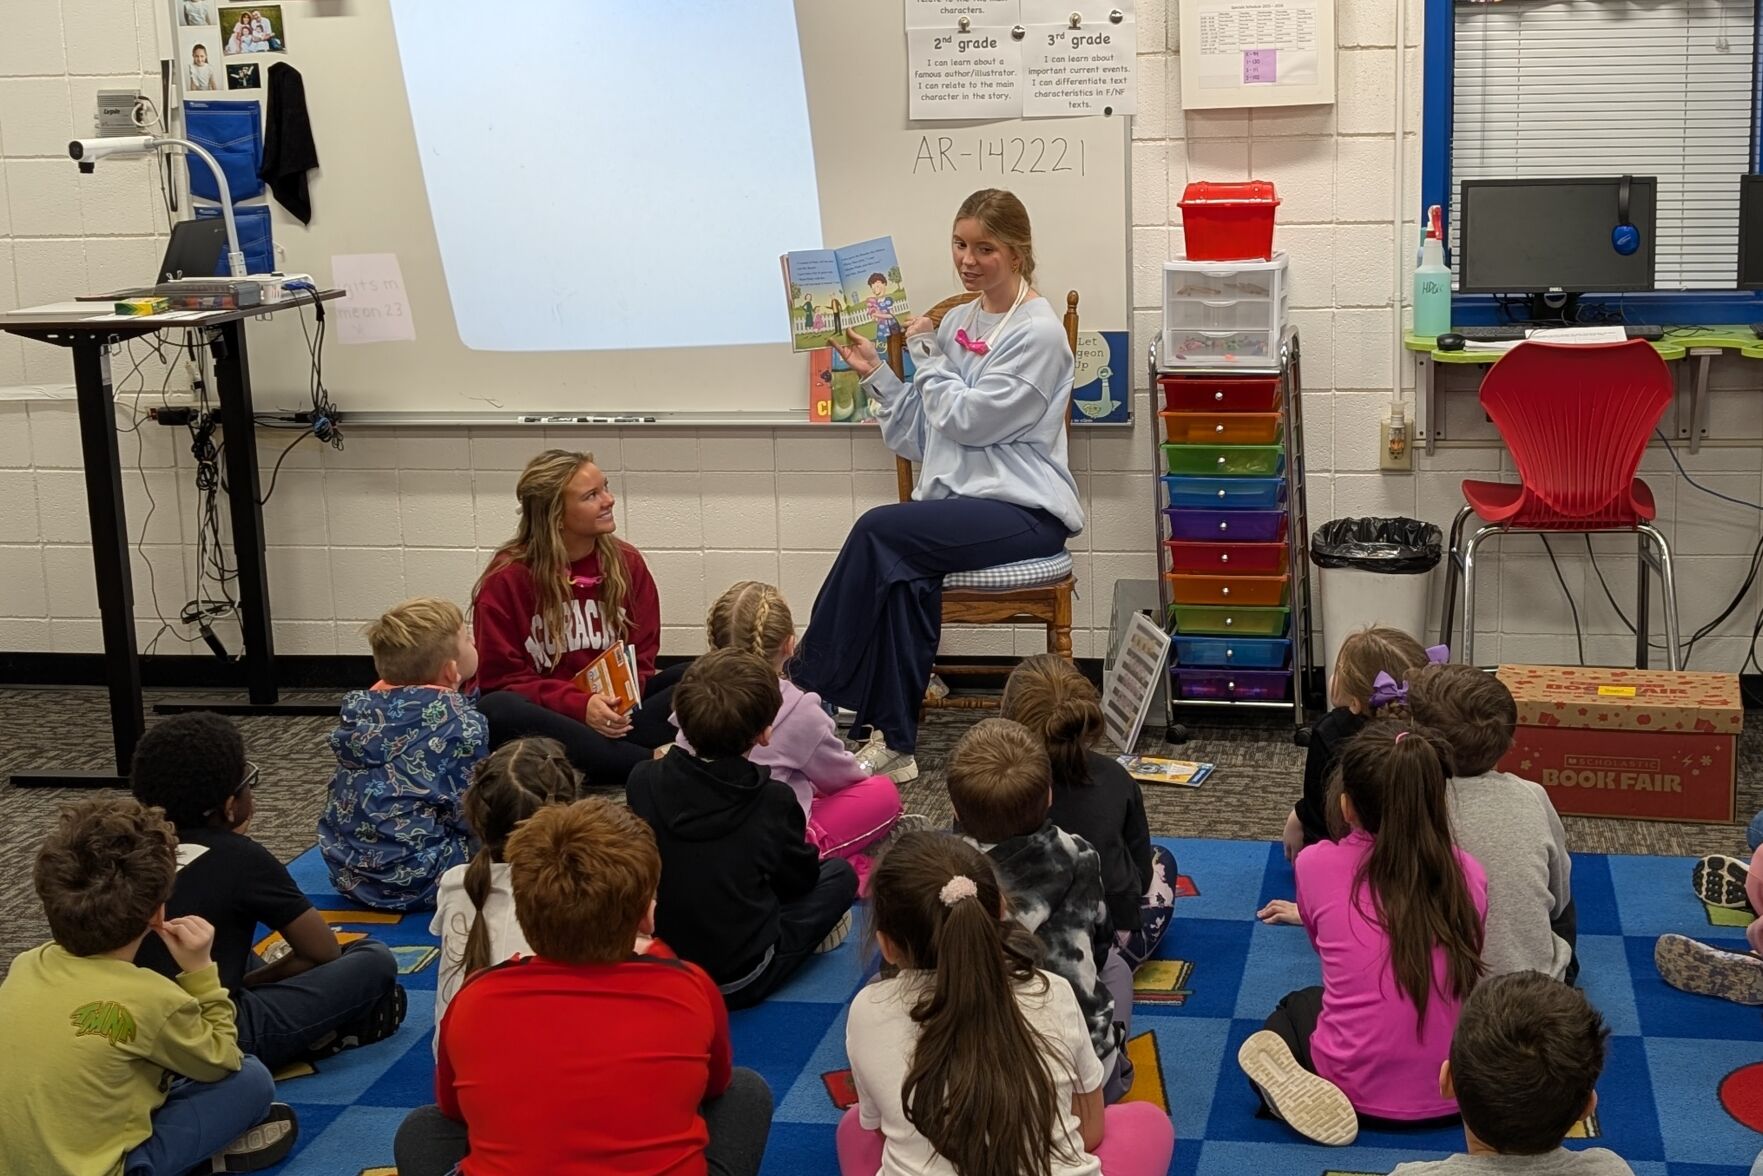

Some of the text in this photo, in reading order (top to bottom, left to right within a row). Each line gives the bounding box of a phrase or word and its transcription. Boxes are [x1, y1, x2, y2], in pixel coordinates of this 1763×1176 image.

[940, 6, 985, 14] characters.
[934, 35, 997, 53] 2nd grade
[1048, 32, 1111, 49] 3rd grade
[973, 58, 996, 66] about
[1068, 55, 1089, 63] learn
[1091, 54, 1114, 62] about
[914, 69, 1017, 78] famous author/illustrator.
[1028, 67, 1066, 76] important
[1069, 66, 1099, 74] current
[995, 80, 1015, 88] main
[1055, 78, 1107, 86] differentiate
[921, 93, 959, 101] character
[973, 92, 986, 100] the
[988, 92, 1012, 101] story.
[1034, 89, 1093, 98] characteristics
[1105, 88, 1126, 96] F/NF
[913, 135, 1086, 176] AR-142221
[1078, 337, 1097, 346] Let
[1076, 350, 1104, 359] geon
[1579, 758, 1657, 769] SCHOLASTIC
[1542, 768, 1682, 792] BOOK FAIR
